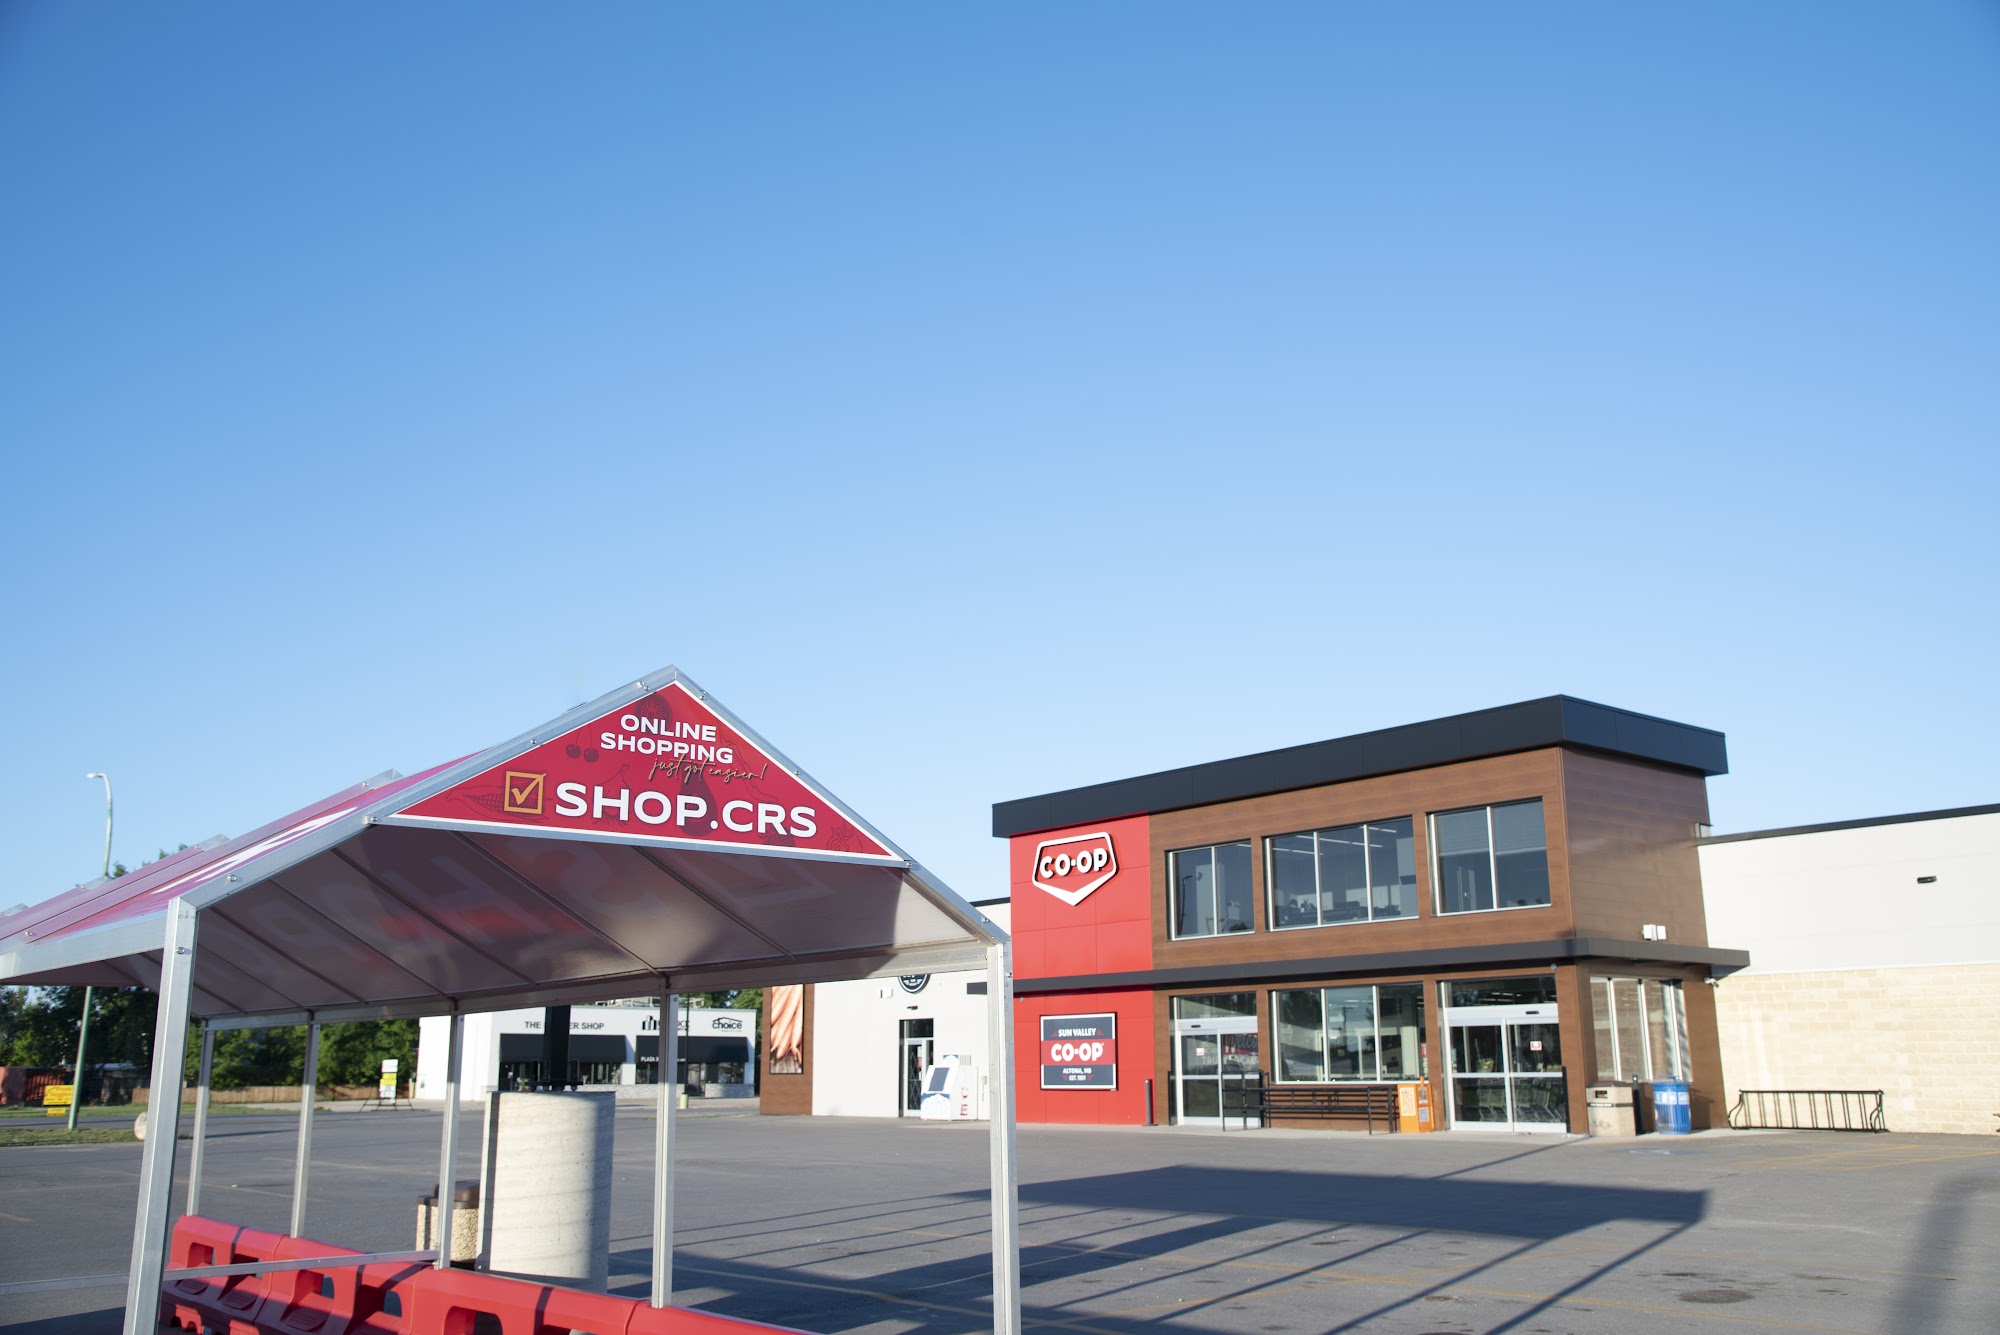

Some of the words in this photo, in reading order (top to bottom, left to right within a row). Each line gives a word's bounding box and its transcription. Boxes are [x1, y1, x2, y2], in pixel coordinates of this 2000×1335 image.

[620, 714, 717, 743] ONLINE
[600, 732, 733, 764] SHOPPING
[648, 753, 692, 781] just
[684, 756, 716, 784] got
[708, 763, 768, 783] easier!
[555, 781, 818, 838] SHOP.CRS
[1040, 847, 1109, 879] CO-OP
[525, 1021, 542, 1029] THE
[581, 1022, 605, 1030] SHOP
[712, 1020, 742, 1029] choice
[1058, 1028, 1073, 1037] SUN
[1073, 1027, 1097, 1037] VALLEY
[1051, 1042, 1104, 1062] CO-OP
